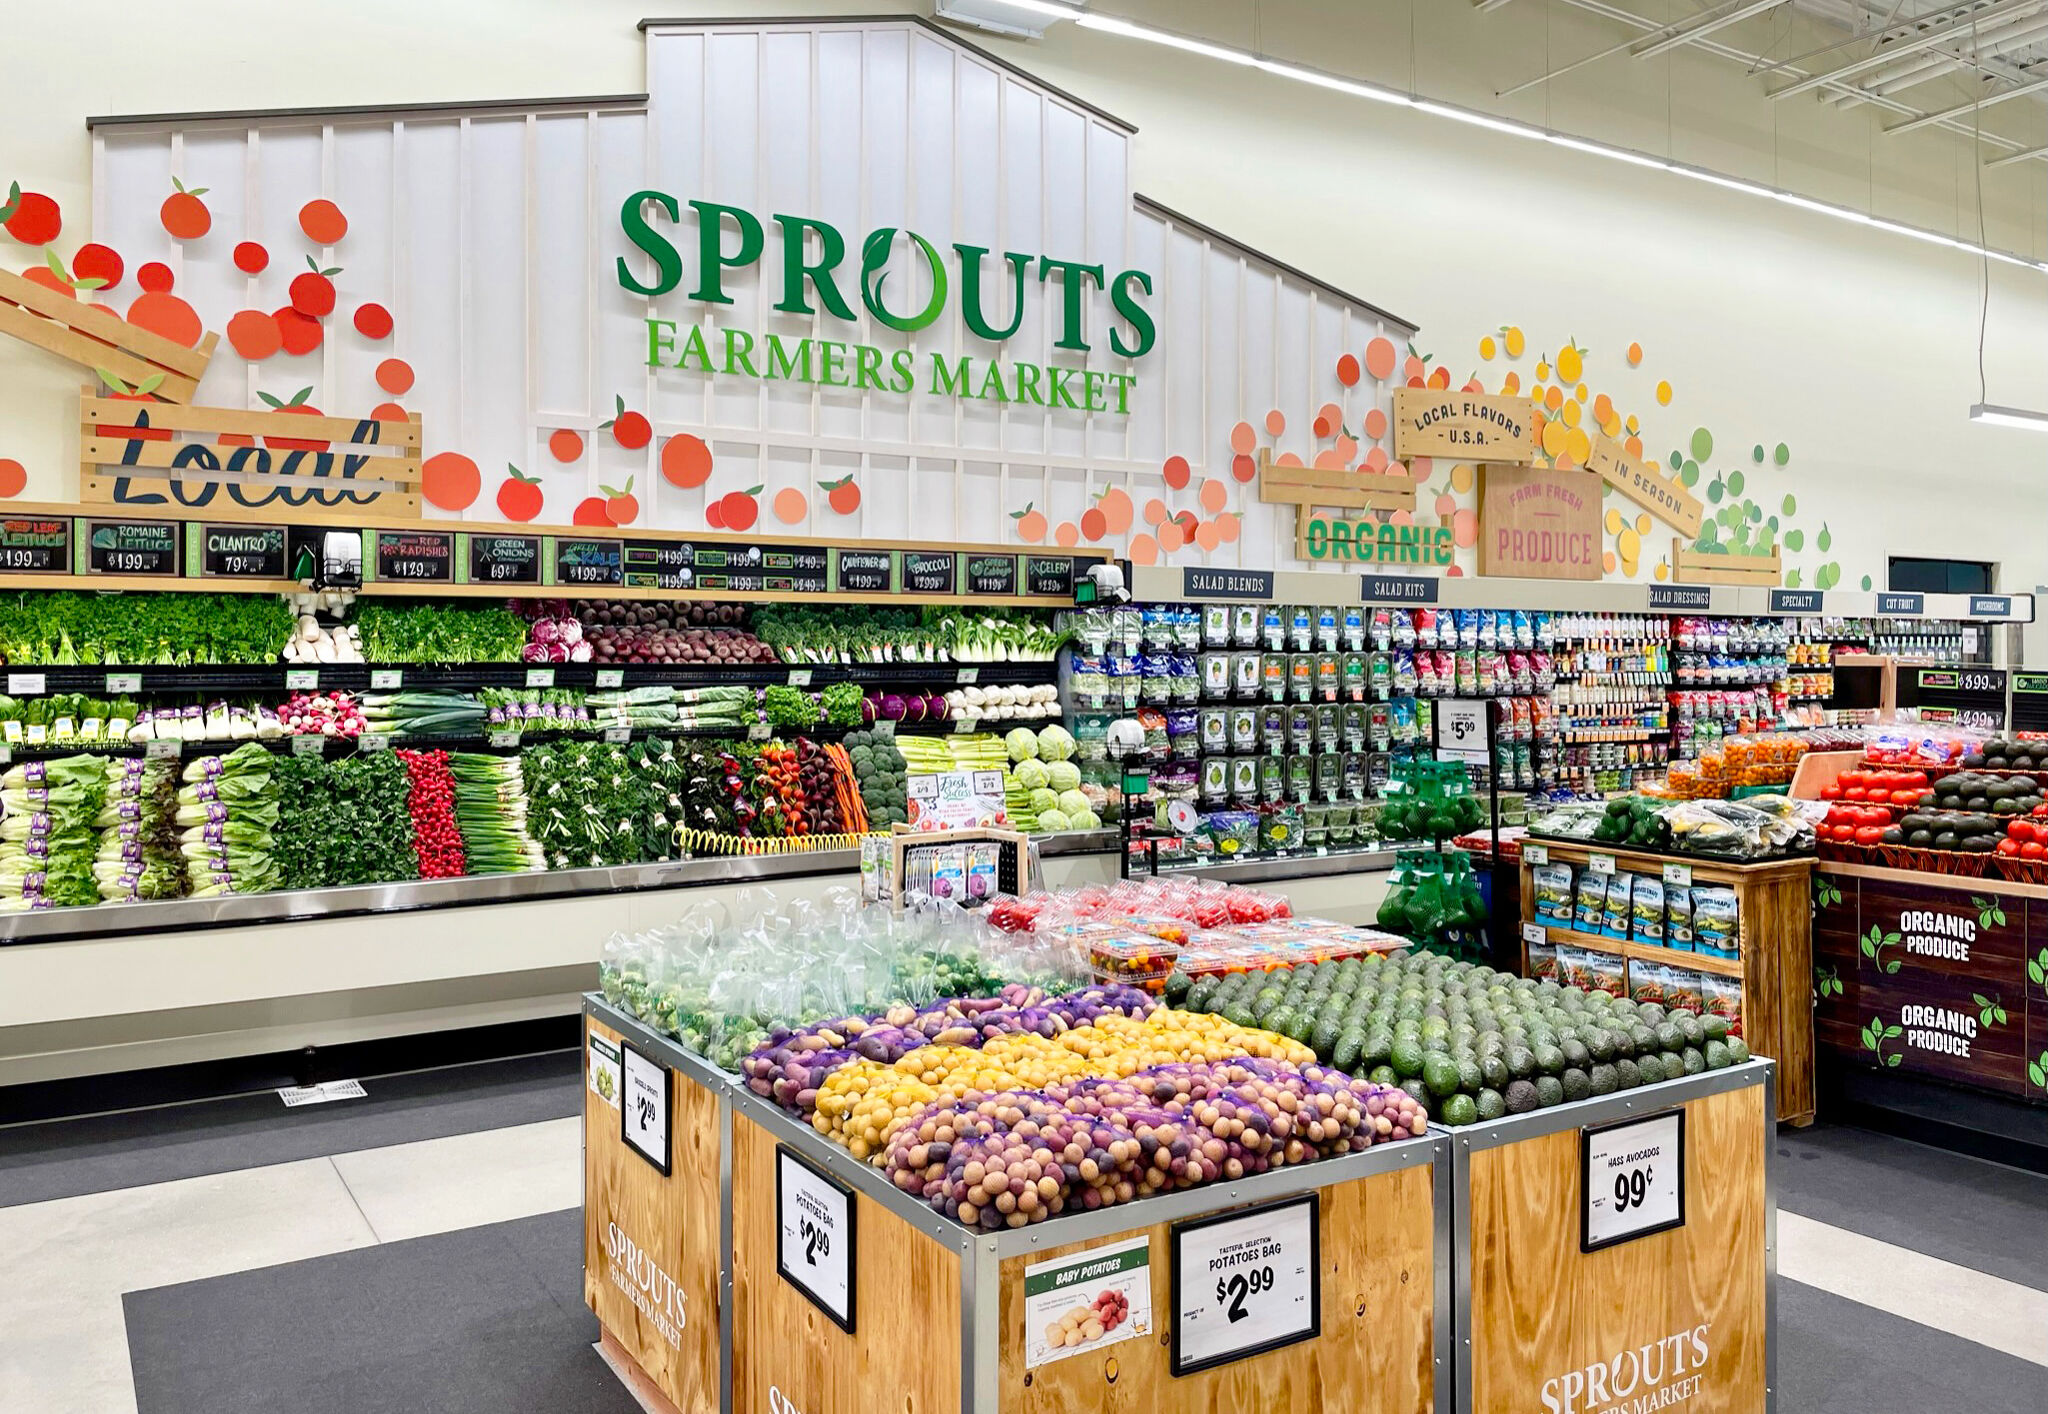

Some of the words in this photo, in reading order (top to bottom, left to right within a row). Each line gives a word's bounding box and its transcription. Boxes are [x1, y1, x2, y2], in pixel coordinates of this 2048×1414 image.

[616, 190, 1157, 359] SPROUTS
[644, 317, 915, 393] FARMERS
[929, 352, 1137, 415] MARKET
[1414, 403, 1457, 432] LOCAL
[1463, 402, 1522, 440] FLAVORS
[1449, 432, 1489, 446] U.S.A.
[113, 409, 385, 507] Local
[1508, 483, 1542, 509] FARM
[1545, 483, 1584, 512] FRESH
[1614, 457, 1630, 479] IN
[1633, 472, 1683, 514] SEASON
[117, 538, 174, 550] LETTUCE
[118, 526, 168, 538] ROMAINE
[208, 534, 267, 552] CILANTRO
[494, 540, 525, 548] GREEN
[1307, 518, 1454, 566] ORGANIC
[1498, 527, 1593, 566] PRODUCE
[492, 548, 535, 558] ONIONS
[912, 557, 950, 574] BROCCOLI
[1040, 561, 1070, 574] CELERY
[1192, 575, 1224, 591] SALAD
[1227, 577, 1264, 592] BLENDS
[1374, 582, 1402, 596] SALAD
[1405, 583, 1425, 597] KITS
[1649, 588, 1671, 604] SALAD
[1673, 589, 1710, 606] DRESSINGS
[1781, 594, 1813, 608] SPECIALTY
[1886, 598, 1897, 609] CUT
[1898, 598, 1915, 610] FRUIT
[1900, 911, 1976, 942] ORGANIC
[1907, 936, 1970, 961] PRODUCE
[1901, 1004, 1977, 1038] ORGANIC
[1908, 1029, 1971, 1058] PRODUCE
[1608, 1155, 1624, 1168] HASS
[1626, 1146, 1660, 1163] AVOCADOS
[1615, 1164, 1653, 1213] 99¢
[796, 1194, 822, 1220] POTATOES
[823, 1213, 834, 1229] BAG
[1209, 1248, 1259, 1272] POTATOES
[1262, 1243, 1281, 1258] BAG
[1219, 1243, 1244, 1254] TASTEFUL
[1245, 1236, 1271, 1248] SELECTION
[608, 1222, 686, 1329] SPROUTS
[1056, 1268, 1080, 1286] BABY
[1080, 1257, 1121, 1280] POTATOES
[611, 1263, 645, 1313] FARMERS
[647, 1301, 682, 1352] MARKET
[1541, 1323, 1710, 1414] SPROUTS
[1633, 1374, 1702, 1414] MARKET
